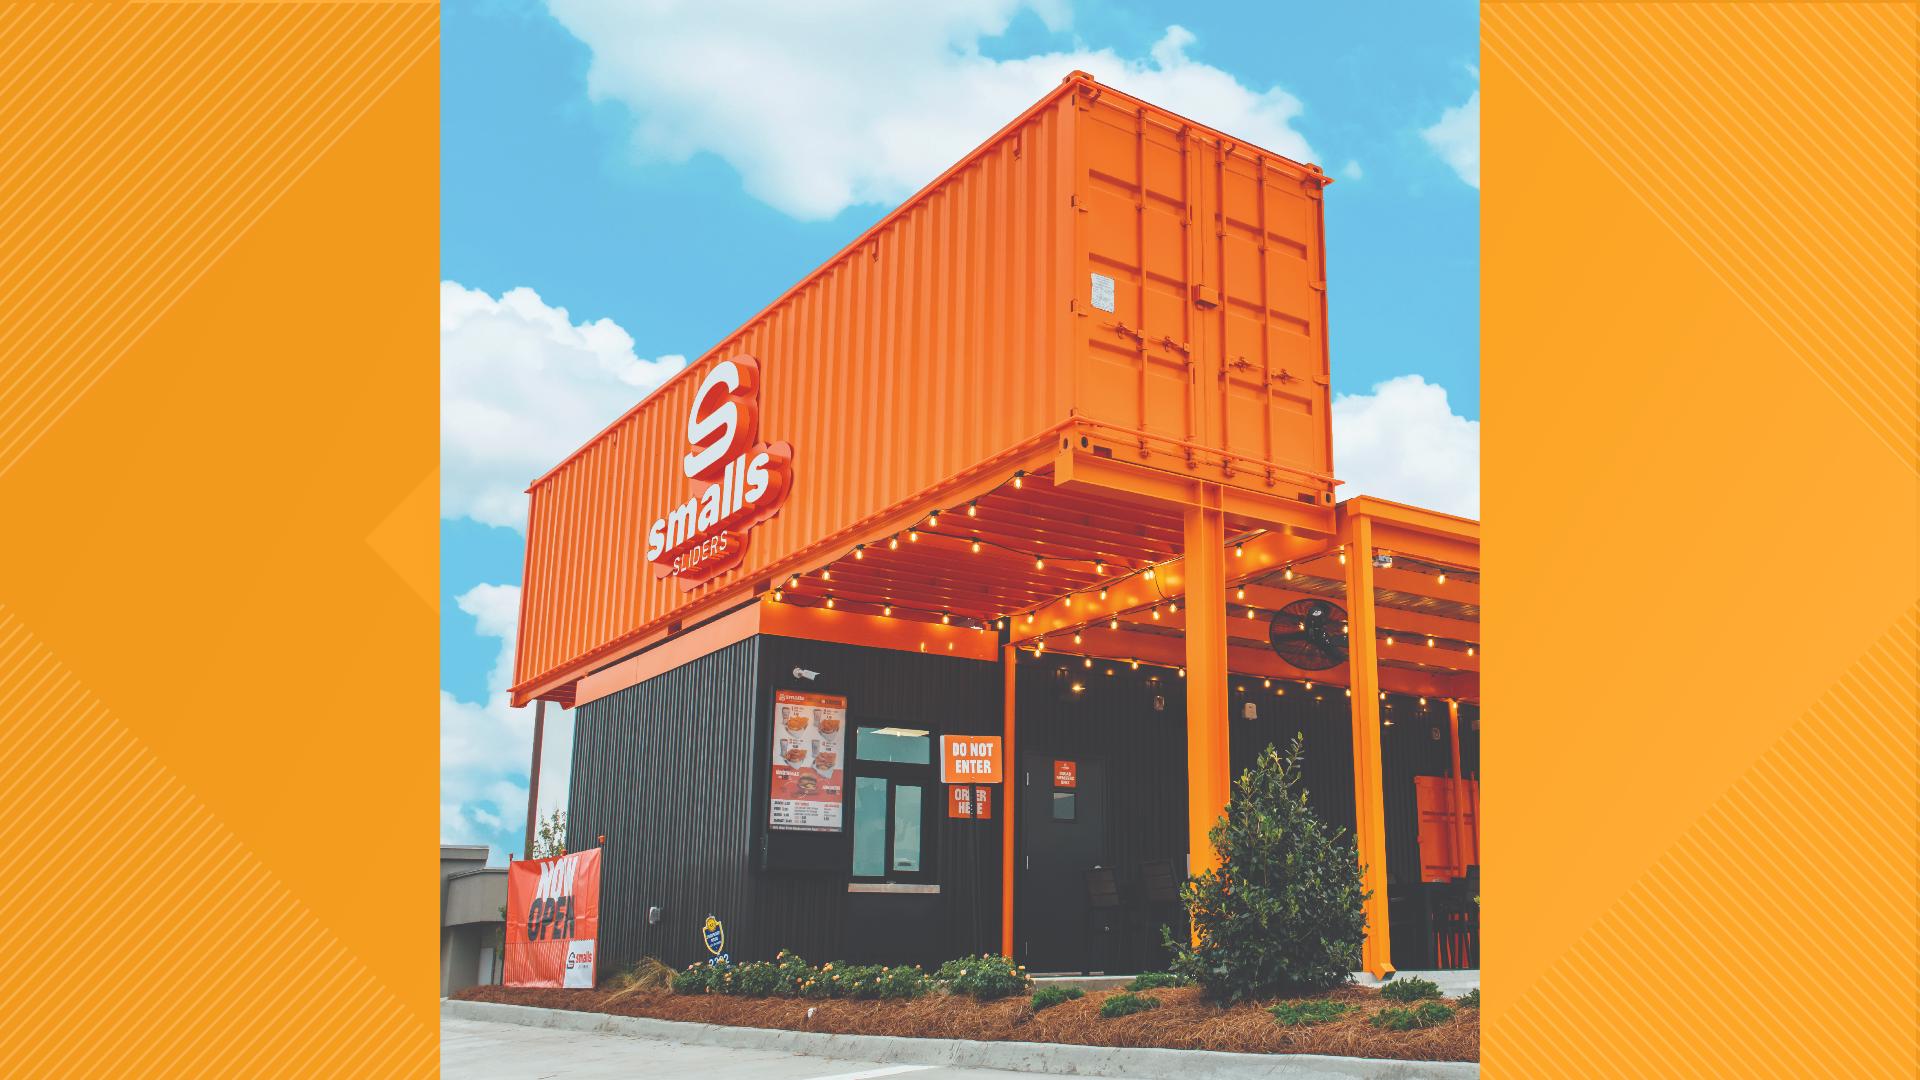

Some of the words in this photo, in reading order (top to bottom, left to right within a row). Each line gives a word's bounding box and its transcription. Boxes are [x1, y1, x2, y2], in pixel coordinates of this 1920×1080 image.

[684, 361, 739, 478] S
[647, 452, 770, 561] smalls
[672, 530, 728, 576] SLIDERS
[952, 742, 967, 757] DO
[970, 742, 993, 757] NOT
[955, 759, 992, 774] ENTER
[954, 788, 987, 802] ORER
[958, 801, 983, 815] HEE
[536, 856, 578, 902] NOW
[527, 895, 575, 941] OPEN
